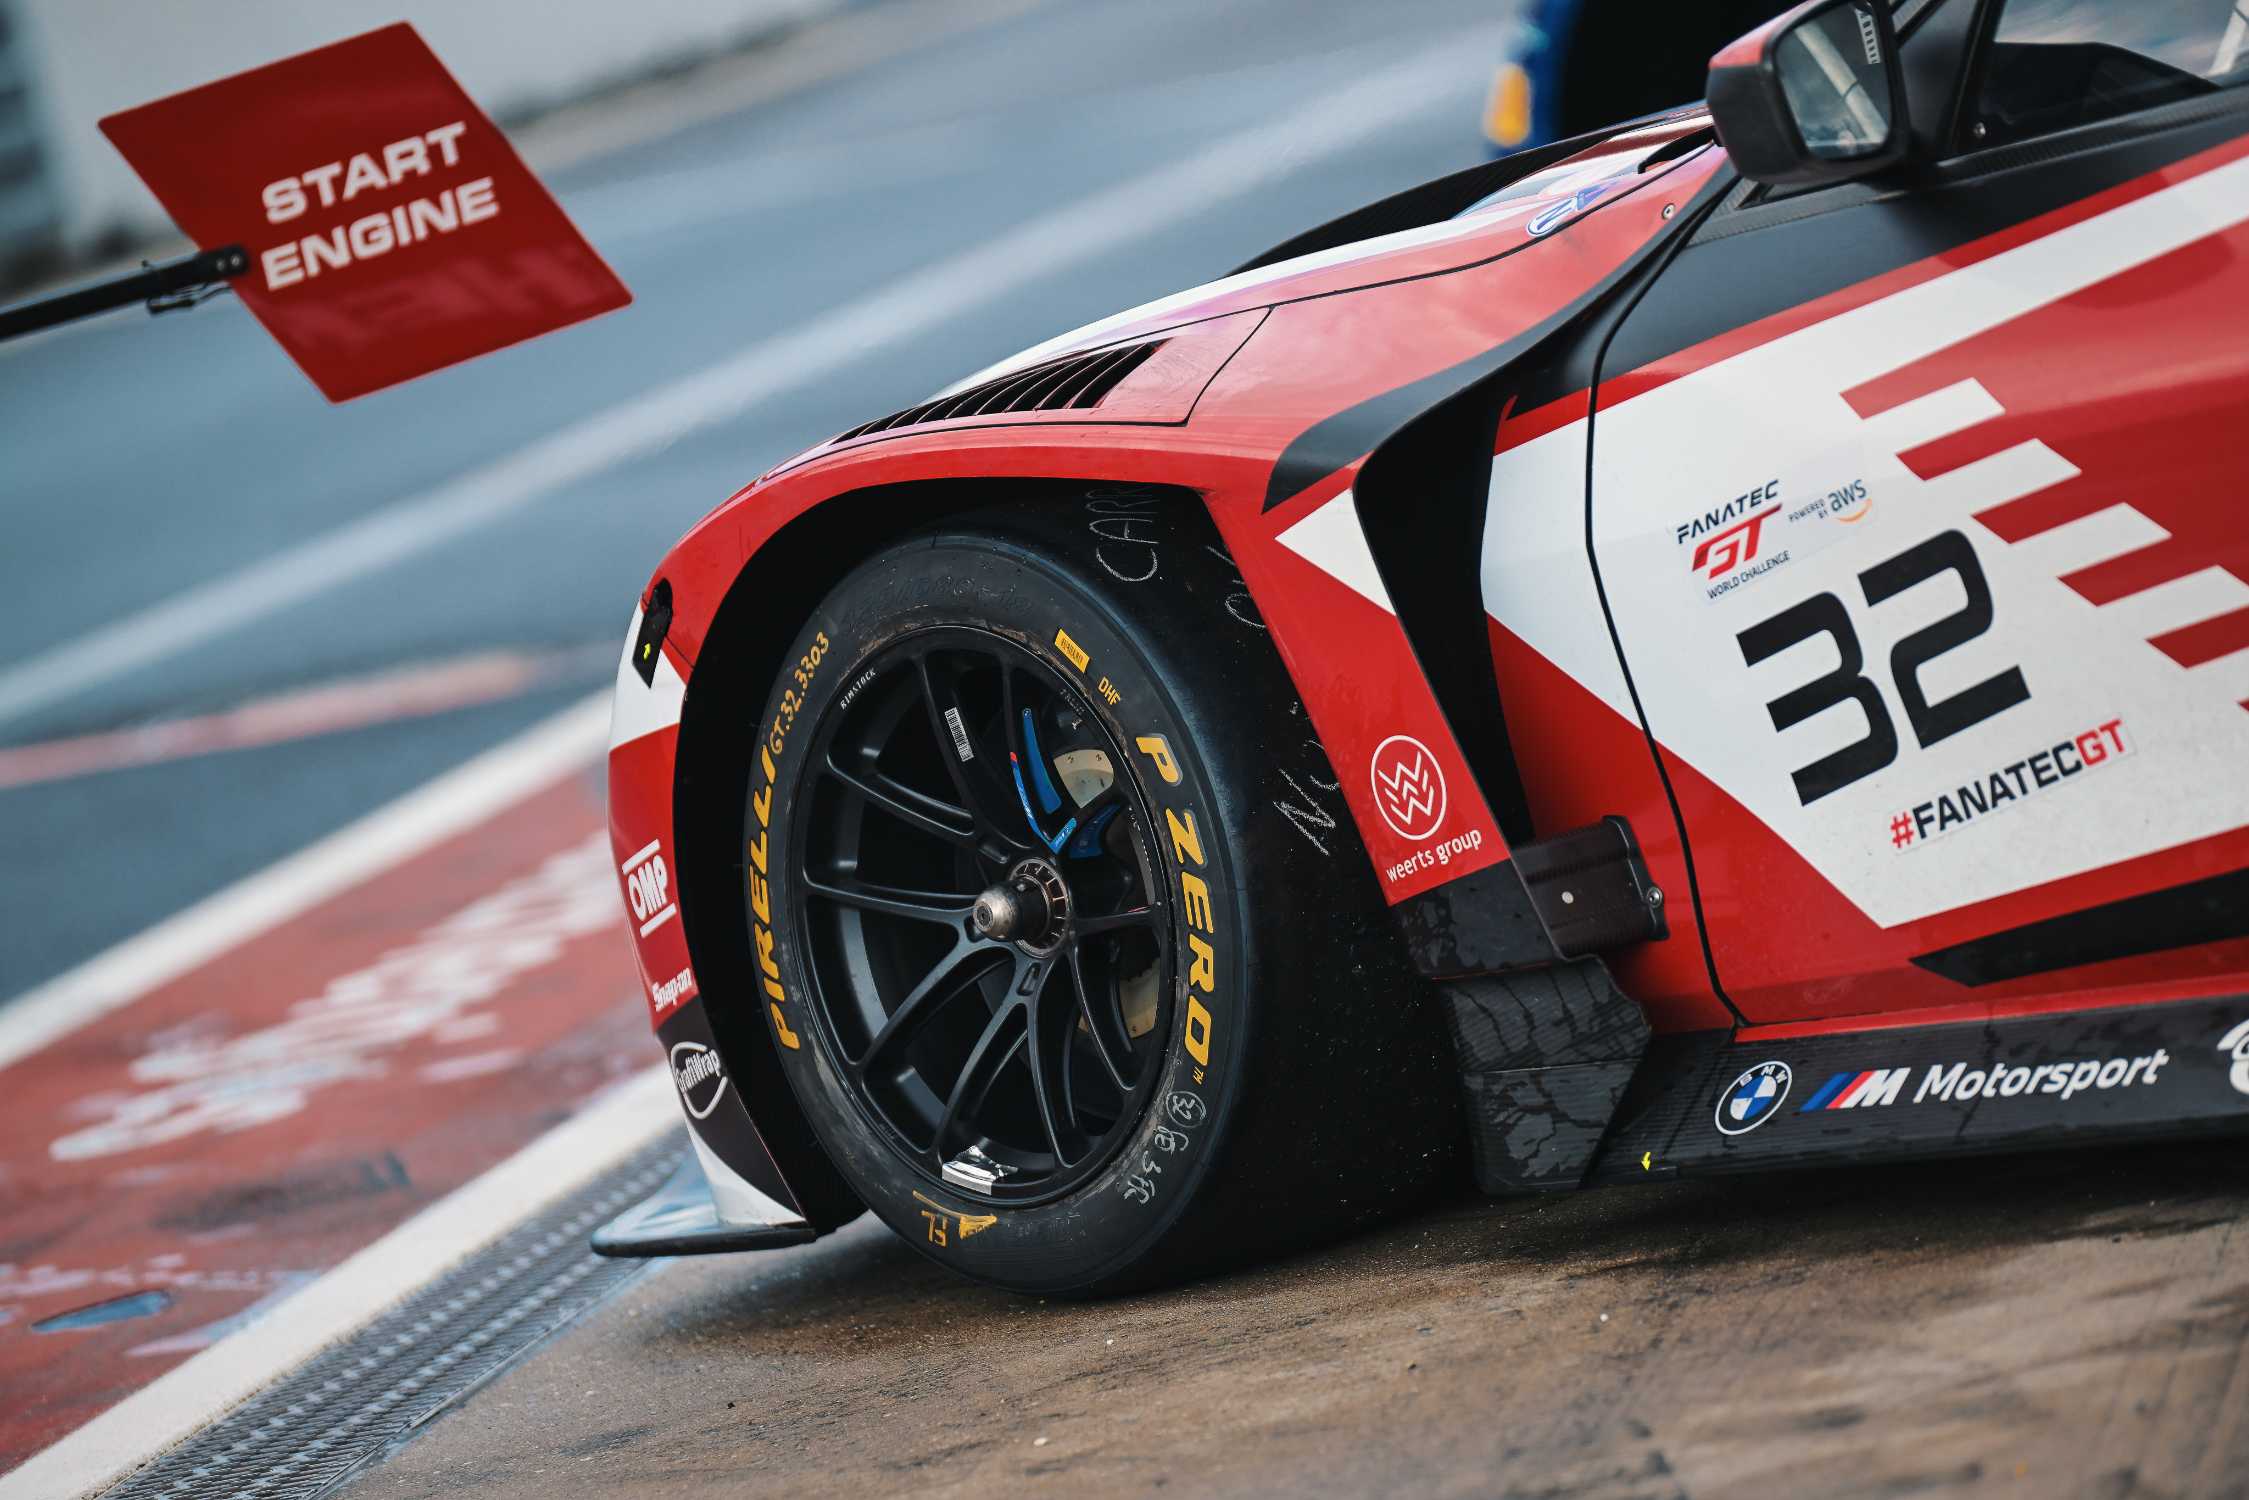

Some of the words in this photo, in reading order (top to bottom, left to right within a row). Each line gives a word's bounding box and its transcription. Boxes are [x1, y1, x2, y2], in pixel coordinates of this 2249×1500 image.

[262, 121, 467, 224] START
[261, 177, 500, 291] ENGINE
[1677, 479, 1779, 544] FANATEC
[1788, 498, 1825, 522] POWERED
[1828, 479, 1867, 512] aws
[1692, 503, 1782, 580] GT
[1706, 576, 1740, 600] WORLD
[1740, 550, 1791, 582] CHALLENGE
[1736, 528, 2031, 807] 32
[1890, 719, 2129, 849] #FANATECGT
[628, 854, 669, 921] OMP
[1386, 850, 1434, 883] weerts
[1436, 829, 1482, 865] group
[749, 744, 800, 1050] PIRELLI
[1136, 735, 1181, 784] P
[1166, 807, 1214, 1066] ZERO
[652, 967, 693, 1012] Snap-on
[1913, 1048, 2170, 1104] Motorsport
